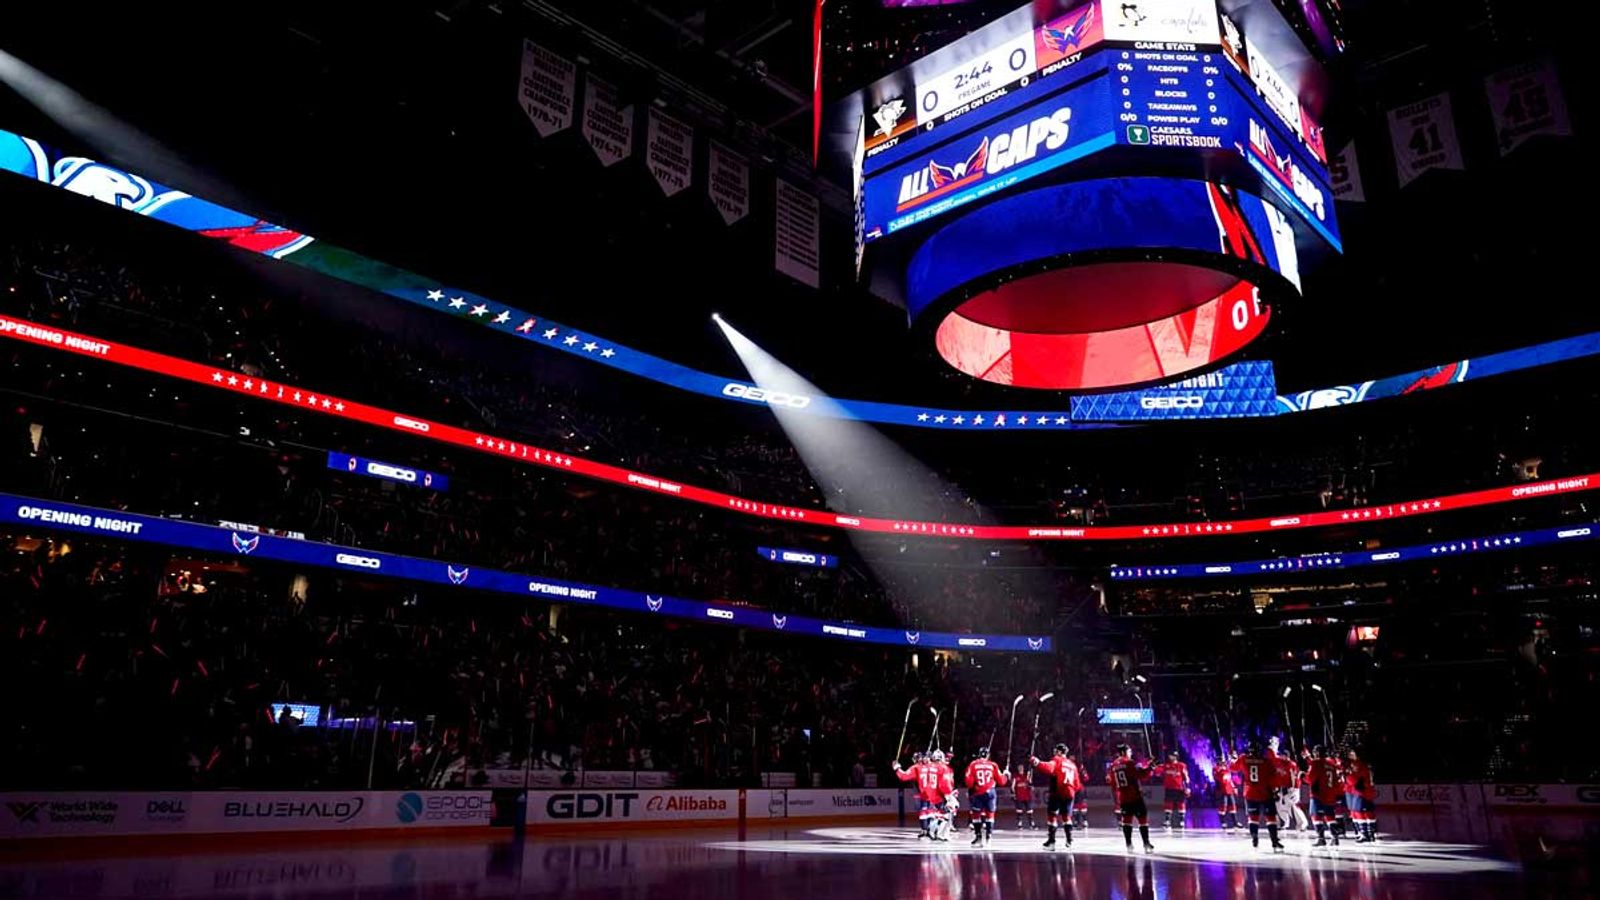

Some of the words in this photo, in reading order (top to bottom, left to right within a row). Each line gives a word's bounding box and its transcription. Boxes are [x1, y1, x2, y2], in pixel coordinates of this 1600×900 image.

[1134, 42, 1164, 50] GAME
[1165, 42, 1196, 51] STATS
[1009, 48, 1026, 71] 0
[1042, 52, 1082, 76] PENALTY
[1122, 51, 1129, 59] 0
[1134, 53, 1161, 61] SHOTS
[1162, 53, 1175, 61] ON
[1176, 54, 1199, 62] GOAL
[1203, 55, 1211, 63] 0
[953, 61, 993, 89] 2:44
[1117, 63, 1133, 72] 0%
[1147, 65, 1188, 73] FACEOFFS
[1203, 66, 1219, 75] 0%
[1121, 75, 1129, 83] 0
[1206, 79, 1214, 87] 0
[923, 91, 938, 112] 0
[1122, 88, 1130, 96] 0
[1155, 90, 1187, 98] BLOCKS
[1208, 92, 1215, 100] 0
[926, 120, 935, 130] 0
[944, 102, 970, 121] SHOTS
[971, 97, 984, 109] ON
[984, 88, 1008, 104] GOAL
[1021, 77, 1030, 87] 0
[1123, 101, 1131, 109] 0
[1147, 103, 1197, 111] TAKEAWAYS
[1209, 105, 1217, 113] 0
[1120, 113, 1137, 122] 0/0
[1147, 115, 1179, 123] POWER
[1180, 116, 1200, 124] PLAY
[1211, 117, 1228, 126] 0/0
[1150, 126, 1193, 135] CAESARS
[1151, 134, 1222, 148] SPORTSBOOK
[1410, 123, 1443, 154] 41
[868, 138, 898, 157] PENALTY
[899, 167, 930, 204] ALL
[986, 107, 1072, 174] CAPS
[0, 320, 63, 343] OPENING
[65, 335, 110, 354] NIGHT
[1183, 372, 1223, 387] NIGHT
[722, 383, 810, 408] GEICO
[1142, 396, 1204, 409] GEICO
[368, 463, 416, 482] GEICO
[628, 474, 660, 489] OPENING
[660, 479, 682, 494] NIGHT
[1512, 483, 1556, 497] OPENING
[1557, 478, 1589, 490] NIGHT
[18, 505, 92, 527] OPENING
[94, 515, 143, 534] NIGHT
[1028, 529, 1061, 537] OPENING
[1062, 529, 1085, 537] NIGHT
[336, 553, 380, 568] GEICO
[783, 551, 815, 564] GEICO
[529, 582, 569, 596] OPENING
[569, 587, 597, 601] NIGHT
[707, 608, 733, 619] GEICO
[822, 625, 848, 636] OPENING
[1114, 771, 1128, 788] 19
[1250, 765, 1259, 782] 8
[50, 800, 86, 811] World
[89, 801, 118, 811] Wide
[147, 801, 185, 813] DELL
[224, 799, 358, 819] BLUEHALO
[427, 796, 493, 809] EPOCH
[546, 793, 639, 819] GDIT
[665, 796, 727, 812] Alibaba
[832, 796, 863, 807] Michael
[49, 811, 115, 823] Technology
